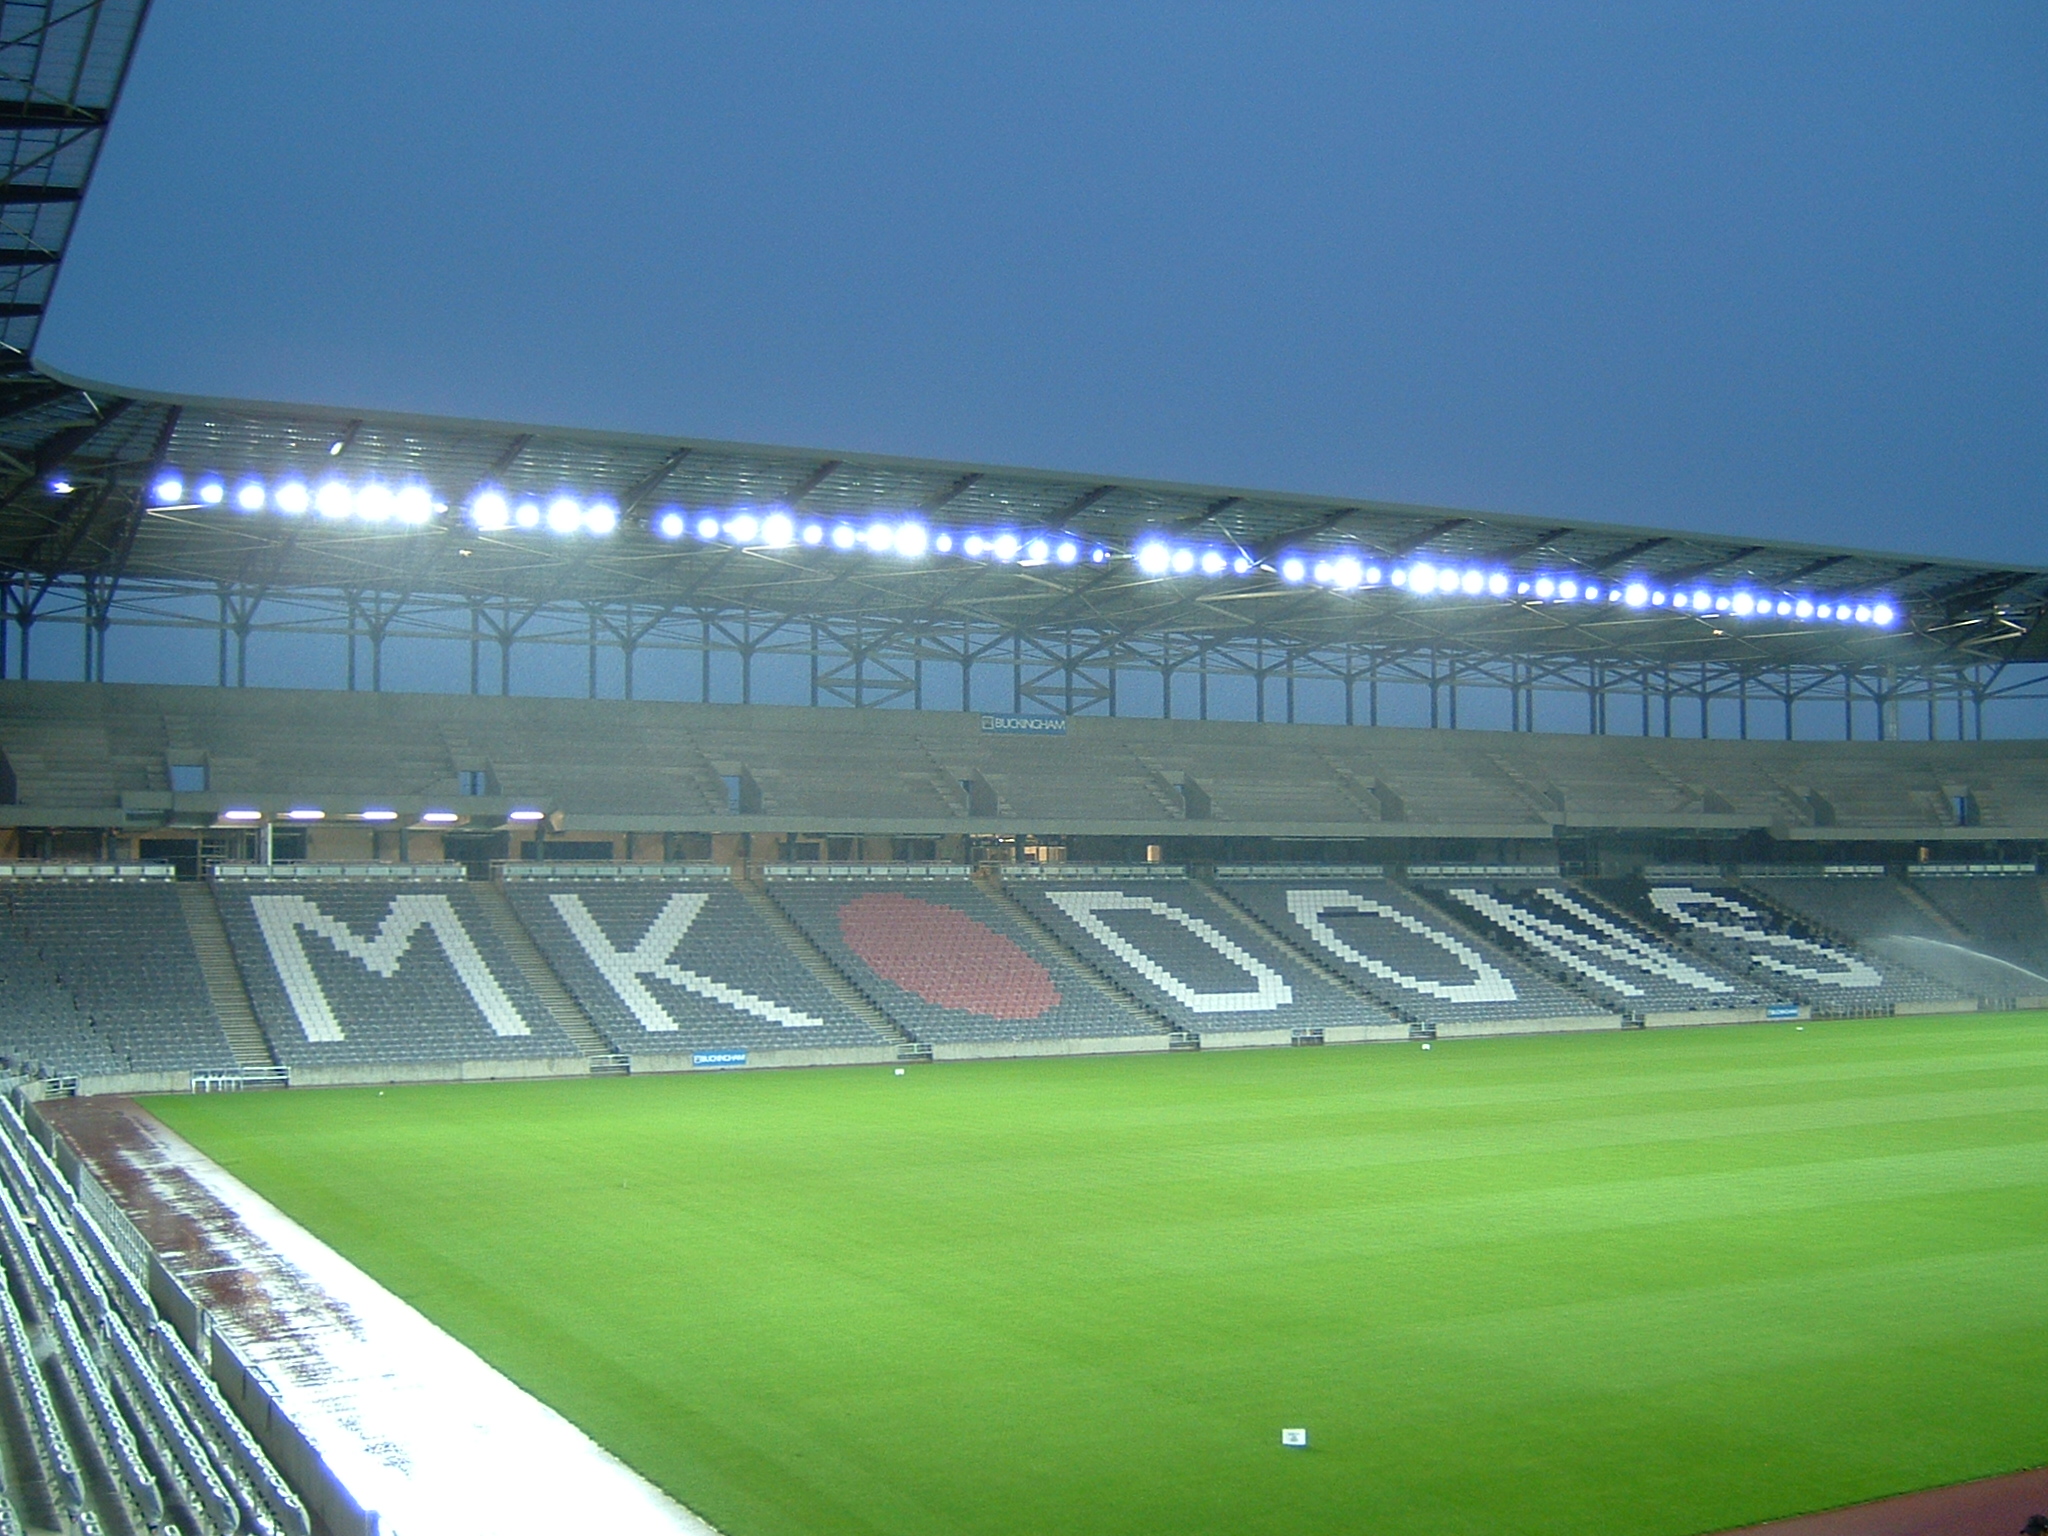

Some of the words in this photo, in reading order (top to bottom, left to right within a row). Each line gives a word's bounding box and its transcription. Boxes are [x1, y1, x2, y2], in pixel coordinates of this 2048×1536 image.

[995, 718, 1066, 730] BUCKINGHAM
[251, 893, 823, 1042] MK
[1045, 887, 1884, 1012] DONS
